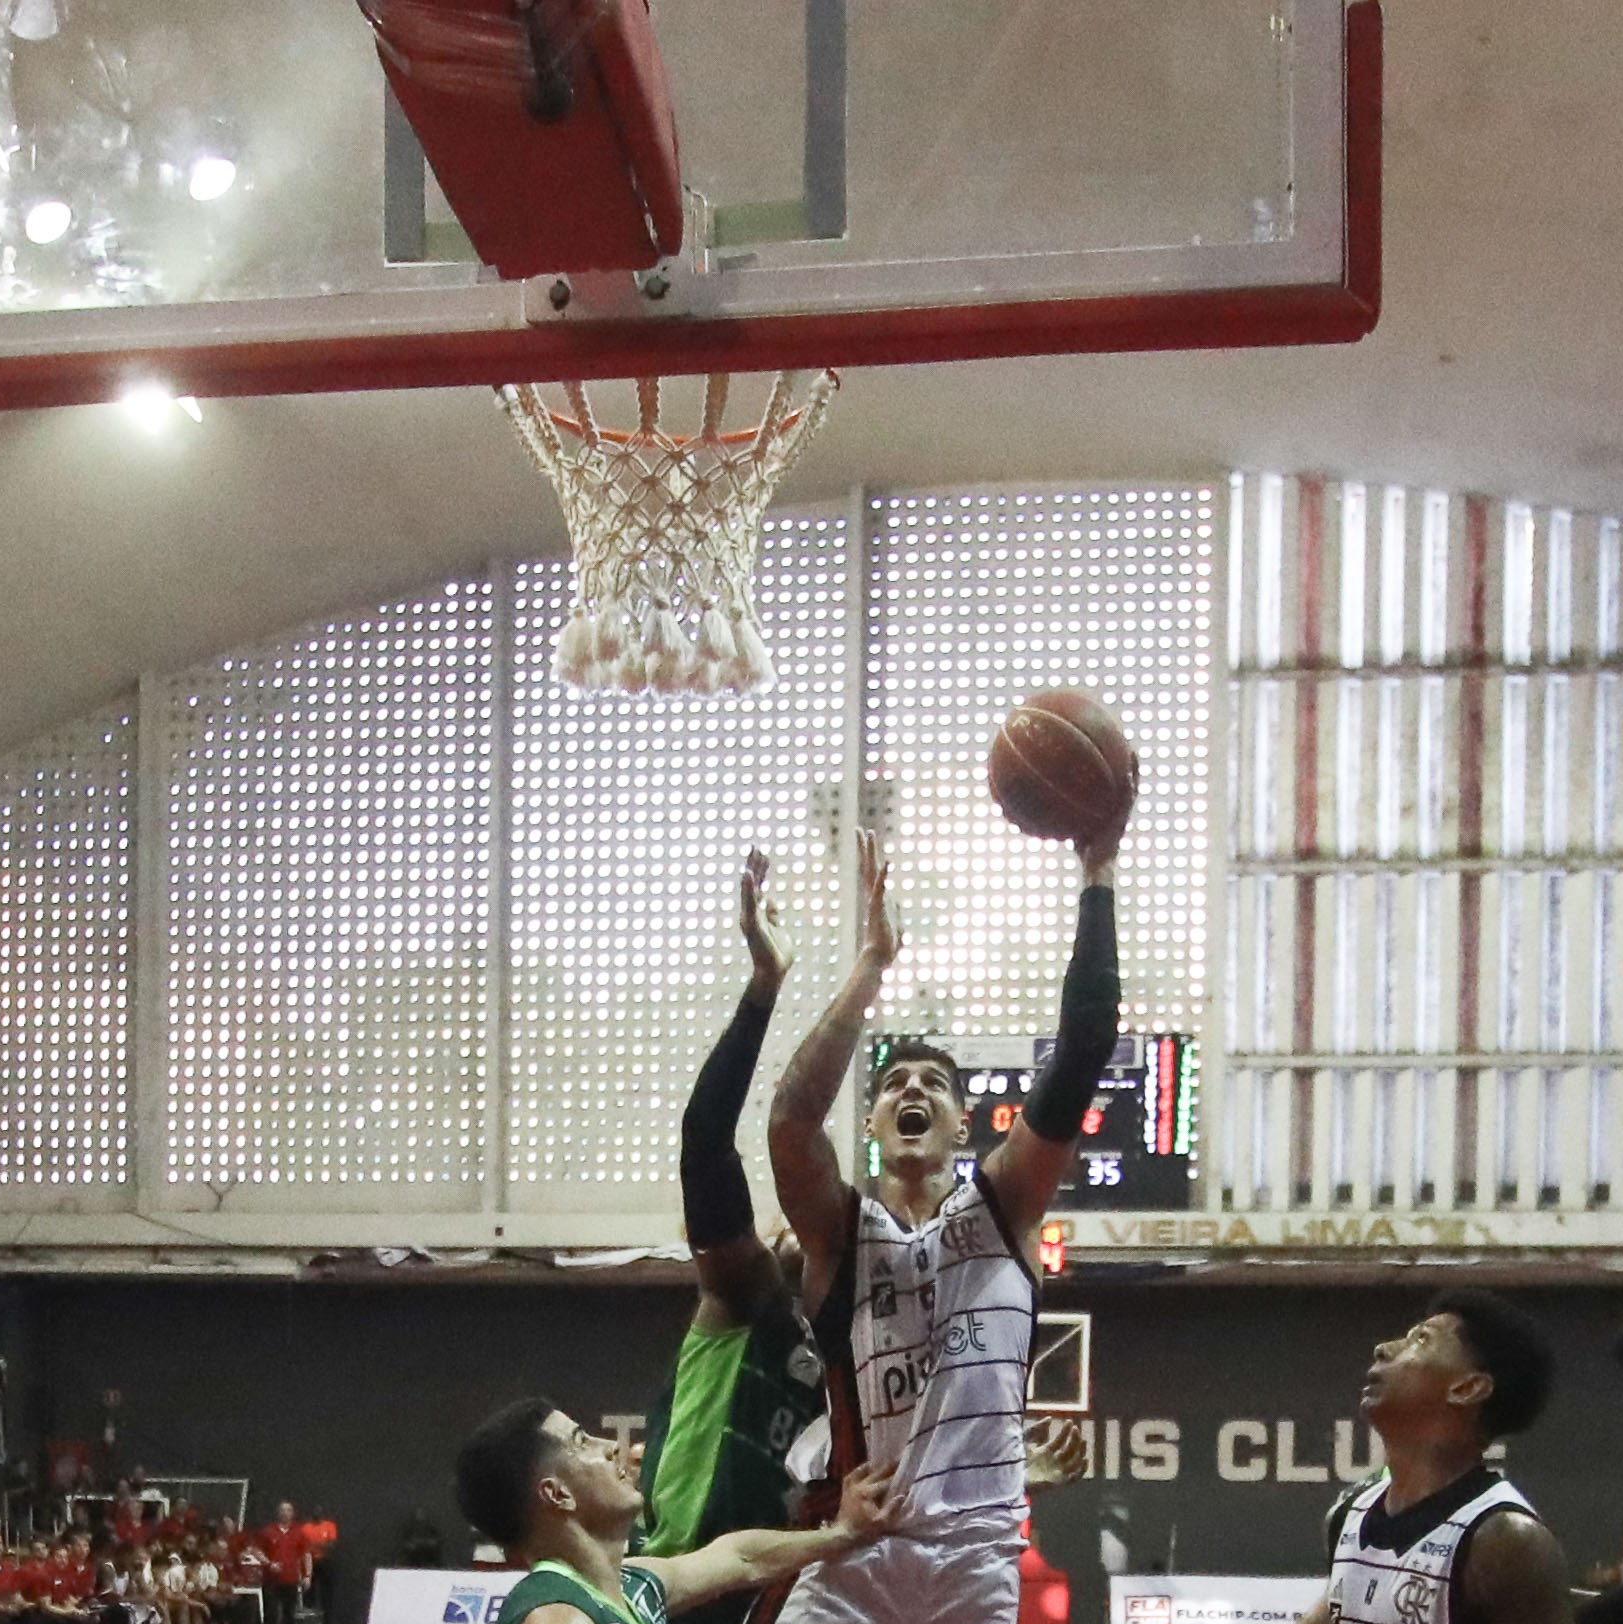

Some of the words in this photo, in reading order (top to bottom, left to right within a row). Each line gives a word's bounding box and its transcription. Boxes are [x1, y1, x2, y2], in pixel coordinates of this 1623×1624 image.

[1087, 1159, 1122, 1186] 35
[1100, 1219, 1259, 1246] VIEIRA
[1282, 1219, 1397, 1246] LIMA
